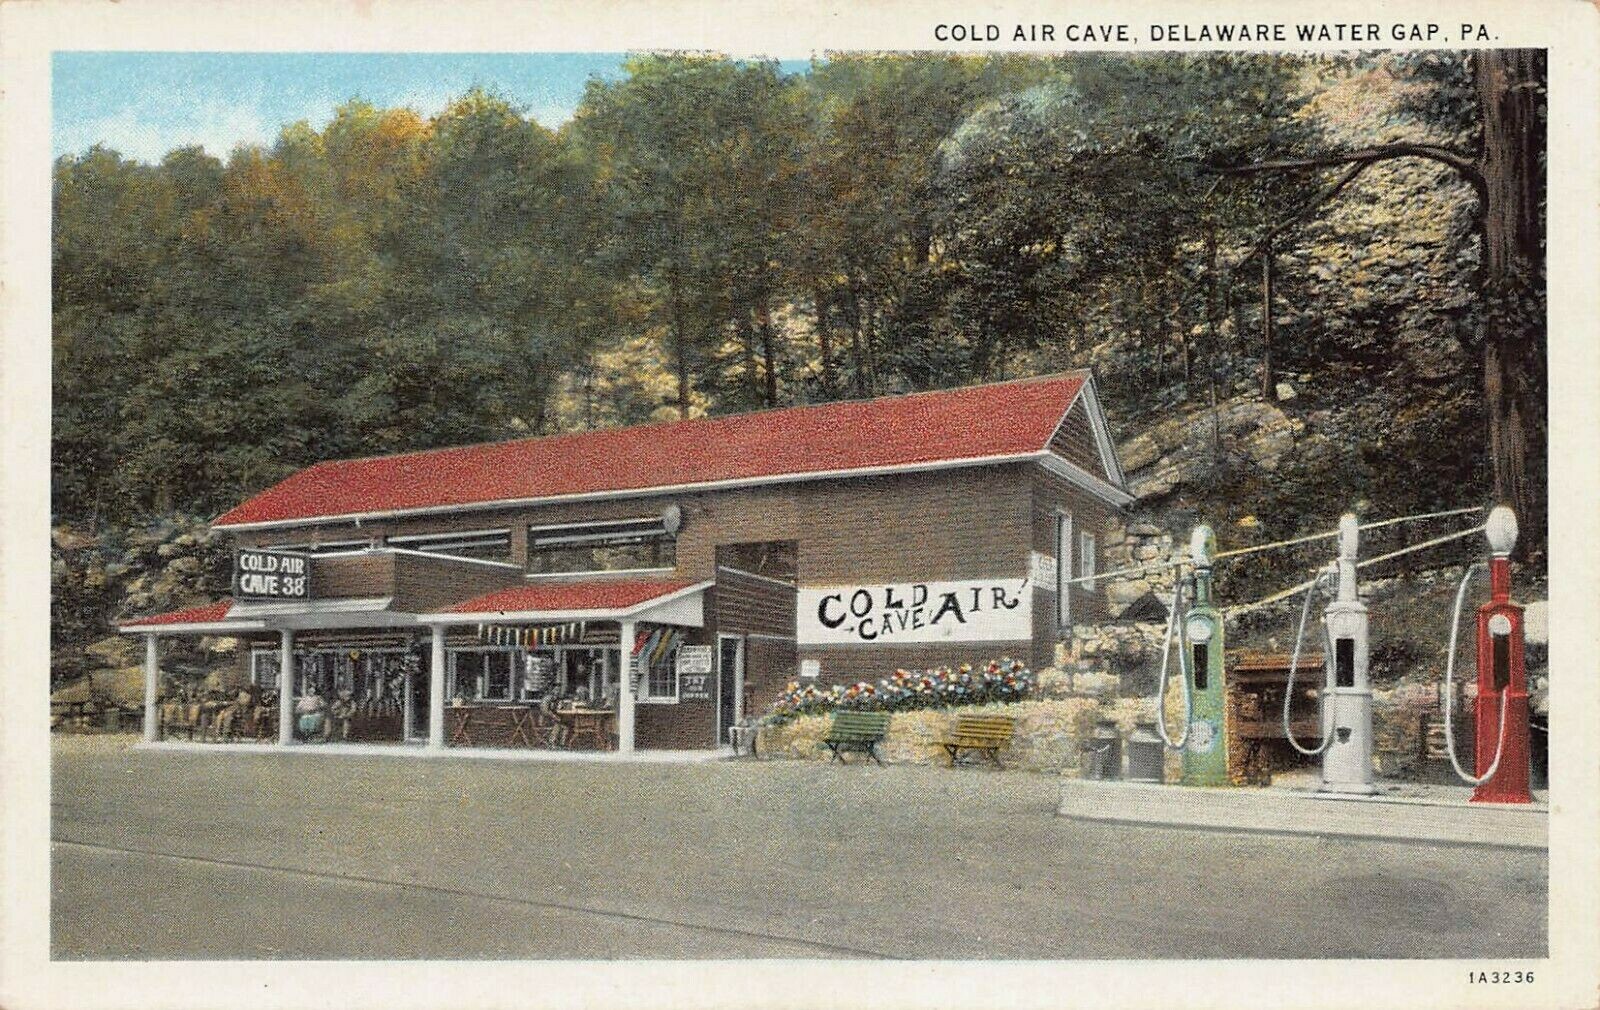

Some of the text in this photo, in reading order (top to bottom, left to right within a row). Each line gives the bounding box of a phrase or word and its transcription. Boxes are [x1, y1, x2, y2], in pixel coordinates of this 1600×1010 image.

[240, 554, 304, 574] COLD AIR
[240, 573, 279, 595] CAVE
[818, 584, 928, 629] COLD
